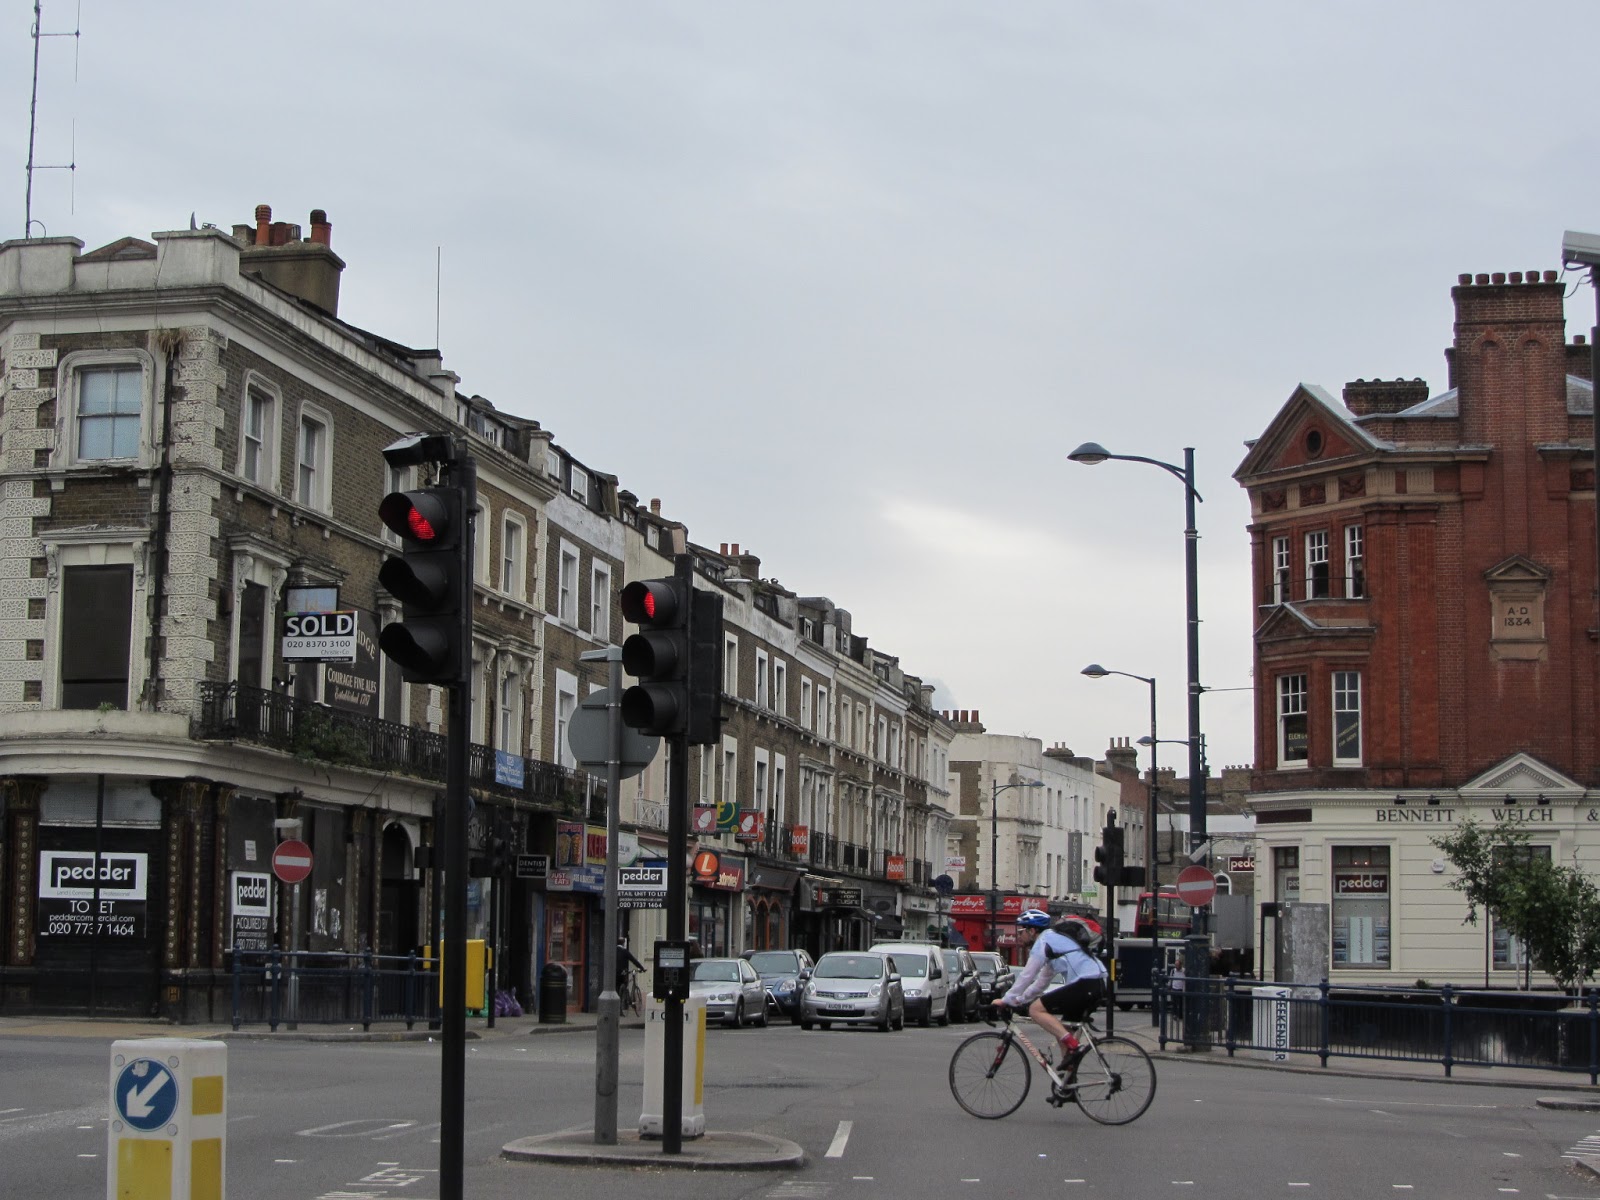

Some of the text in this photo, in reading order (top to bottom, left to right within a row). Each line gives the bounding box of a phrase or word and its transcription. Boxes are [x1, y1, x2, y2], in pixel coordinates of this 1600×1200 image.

[286, 614, 353, 637] SOLD
[1504, 617, 1532, 627] 1884
[286, 640, 351, 648] 020 8370 3100
[327, 667, 353, 688] COURAGE
[353, 676, 365, 691] FINE
[1376, 808, 1599, 823] BENNETT WELCH &
[701, 854, 712, 872] L
[887, 861, 904, 873] Abode
[57, 859, 132, 888] pedder
[622, 869, 661, 885] pedder
[238, 878, 267, 905] pedder
[1338, 875, 1385, 893] pedder
[69, 900, 116, 914] TO ET
[49, 913, 136, 923] peddercomercial.com
[236, 917, 262, 930] ACQUIRED
[49, 922, 72, 935] 020
[106, 923, 135, 936] 1464
[1275, 990, 1287, 1061] WEEKENDR
